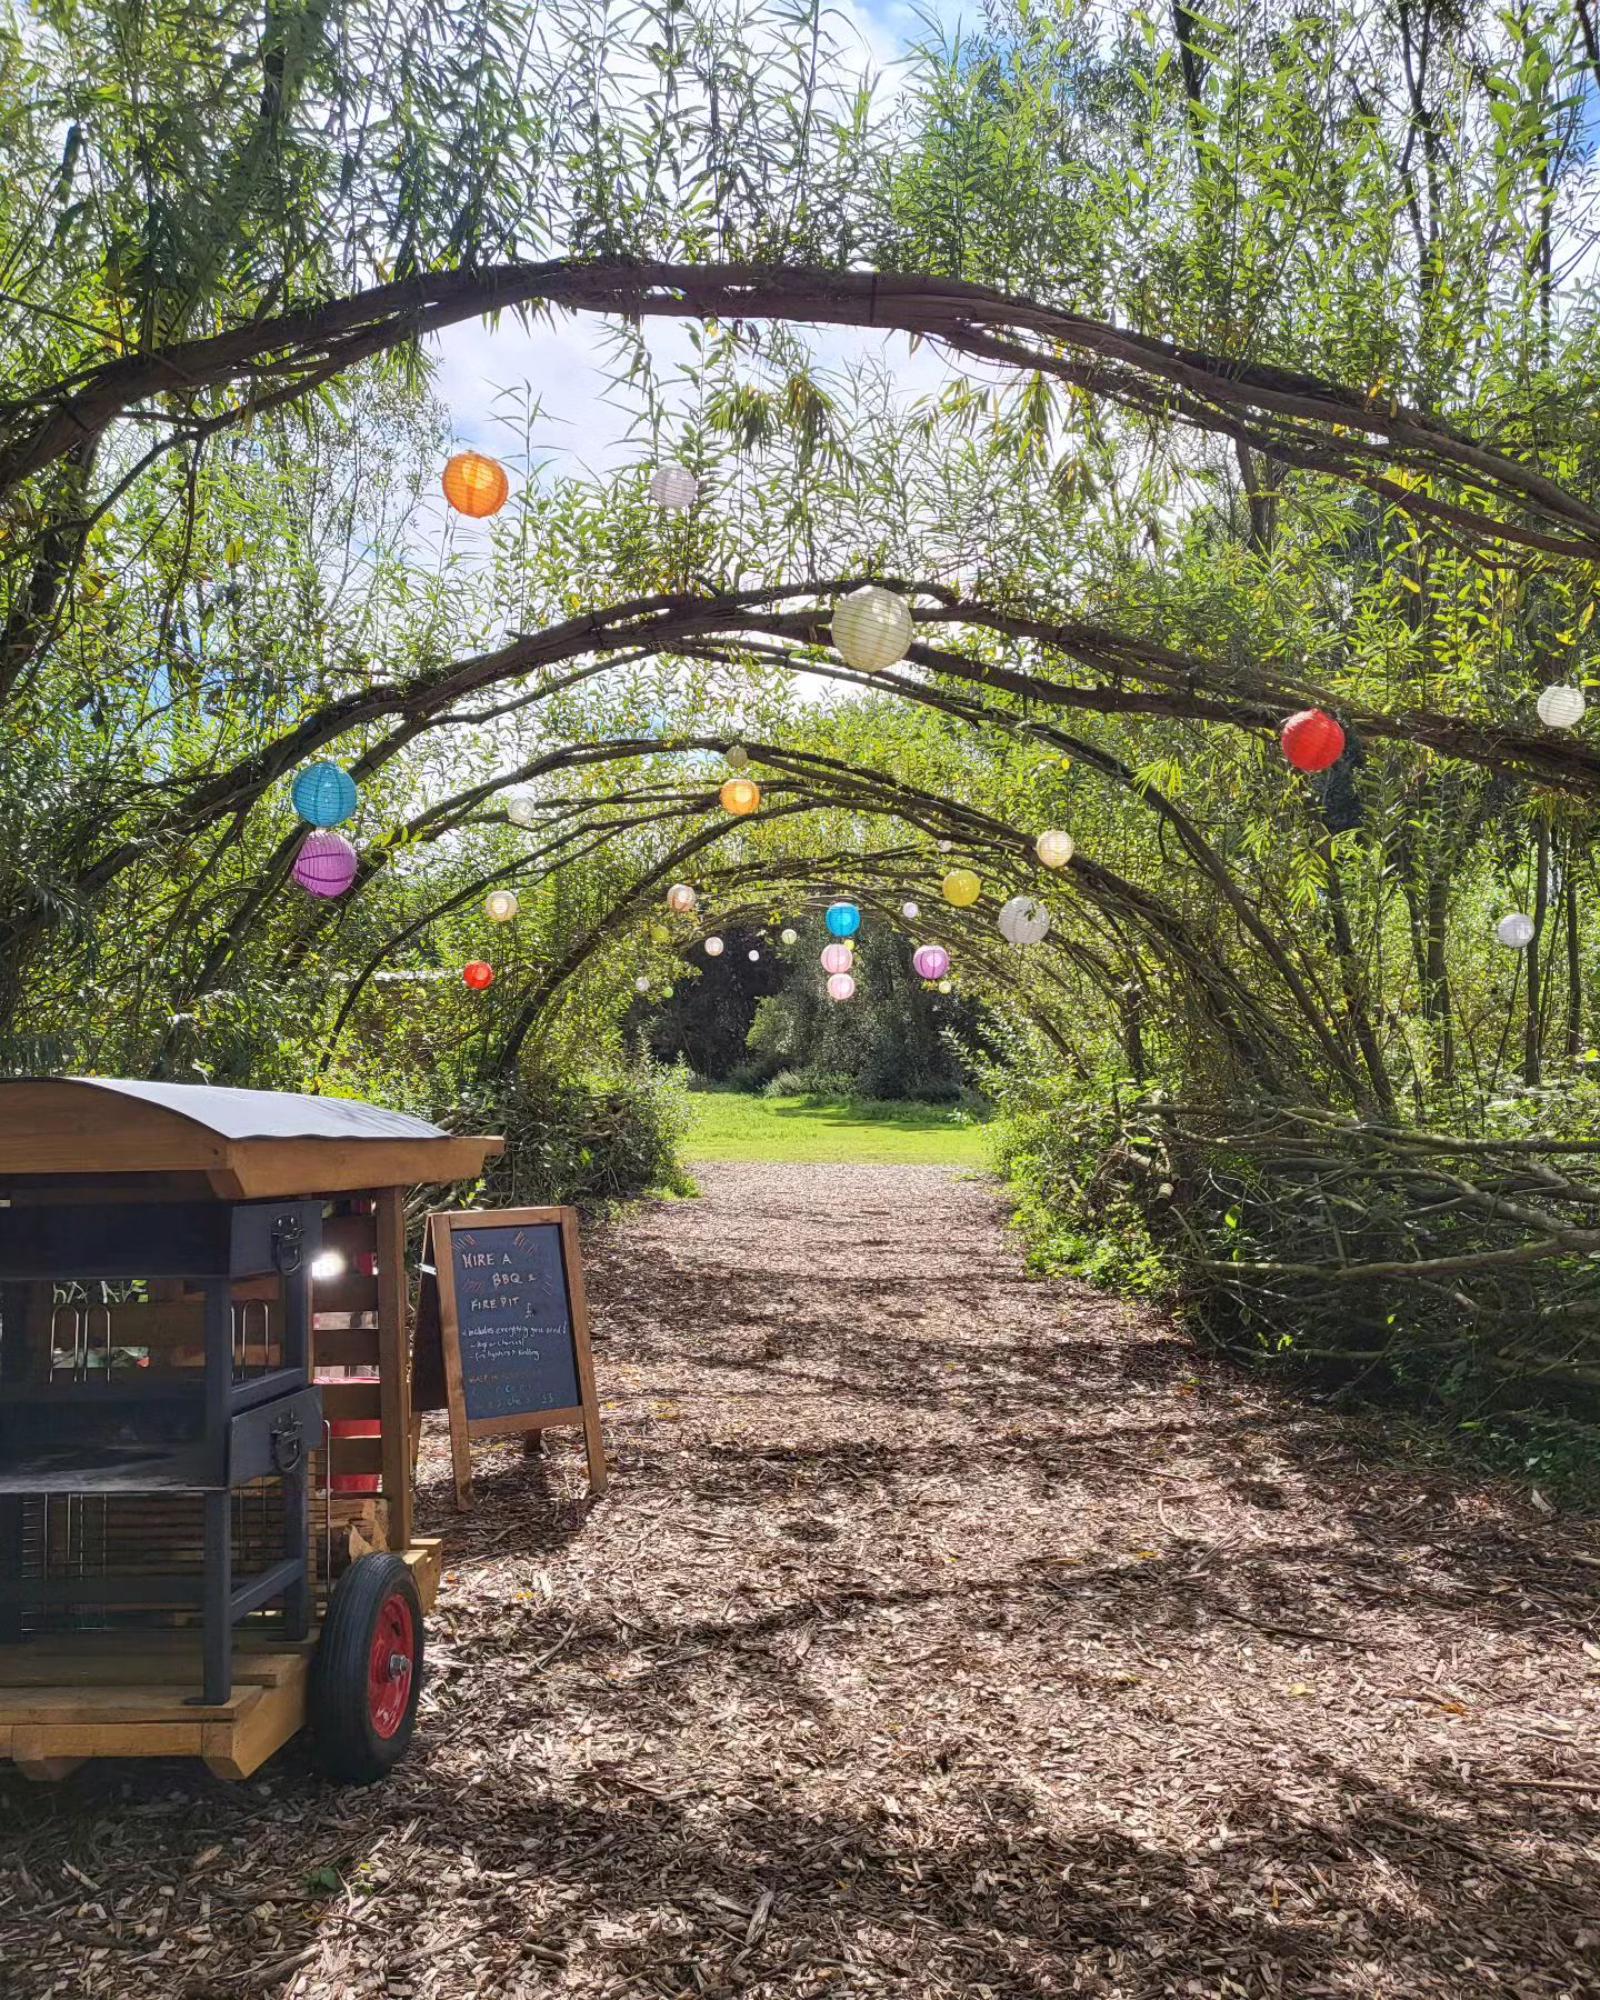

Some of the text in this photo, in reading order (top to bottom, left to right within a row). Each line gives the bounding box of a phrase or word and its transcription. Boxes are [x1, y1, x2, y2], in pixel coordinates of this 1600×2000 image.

[462, 1252, 512, 1269] HIRE A
[492, 1272, 523, 1288] BBQ
[470, 1296, 520, 1312] FIRE PIT
